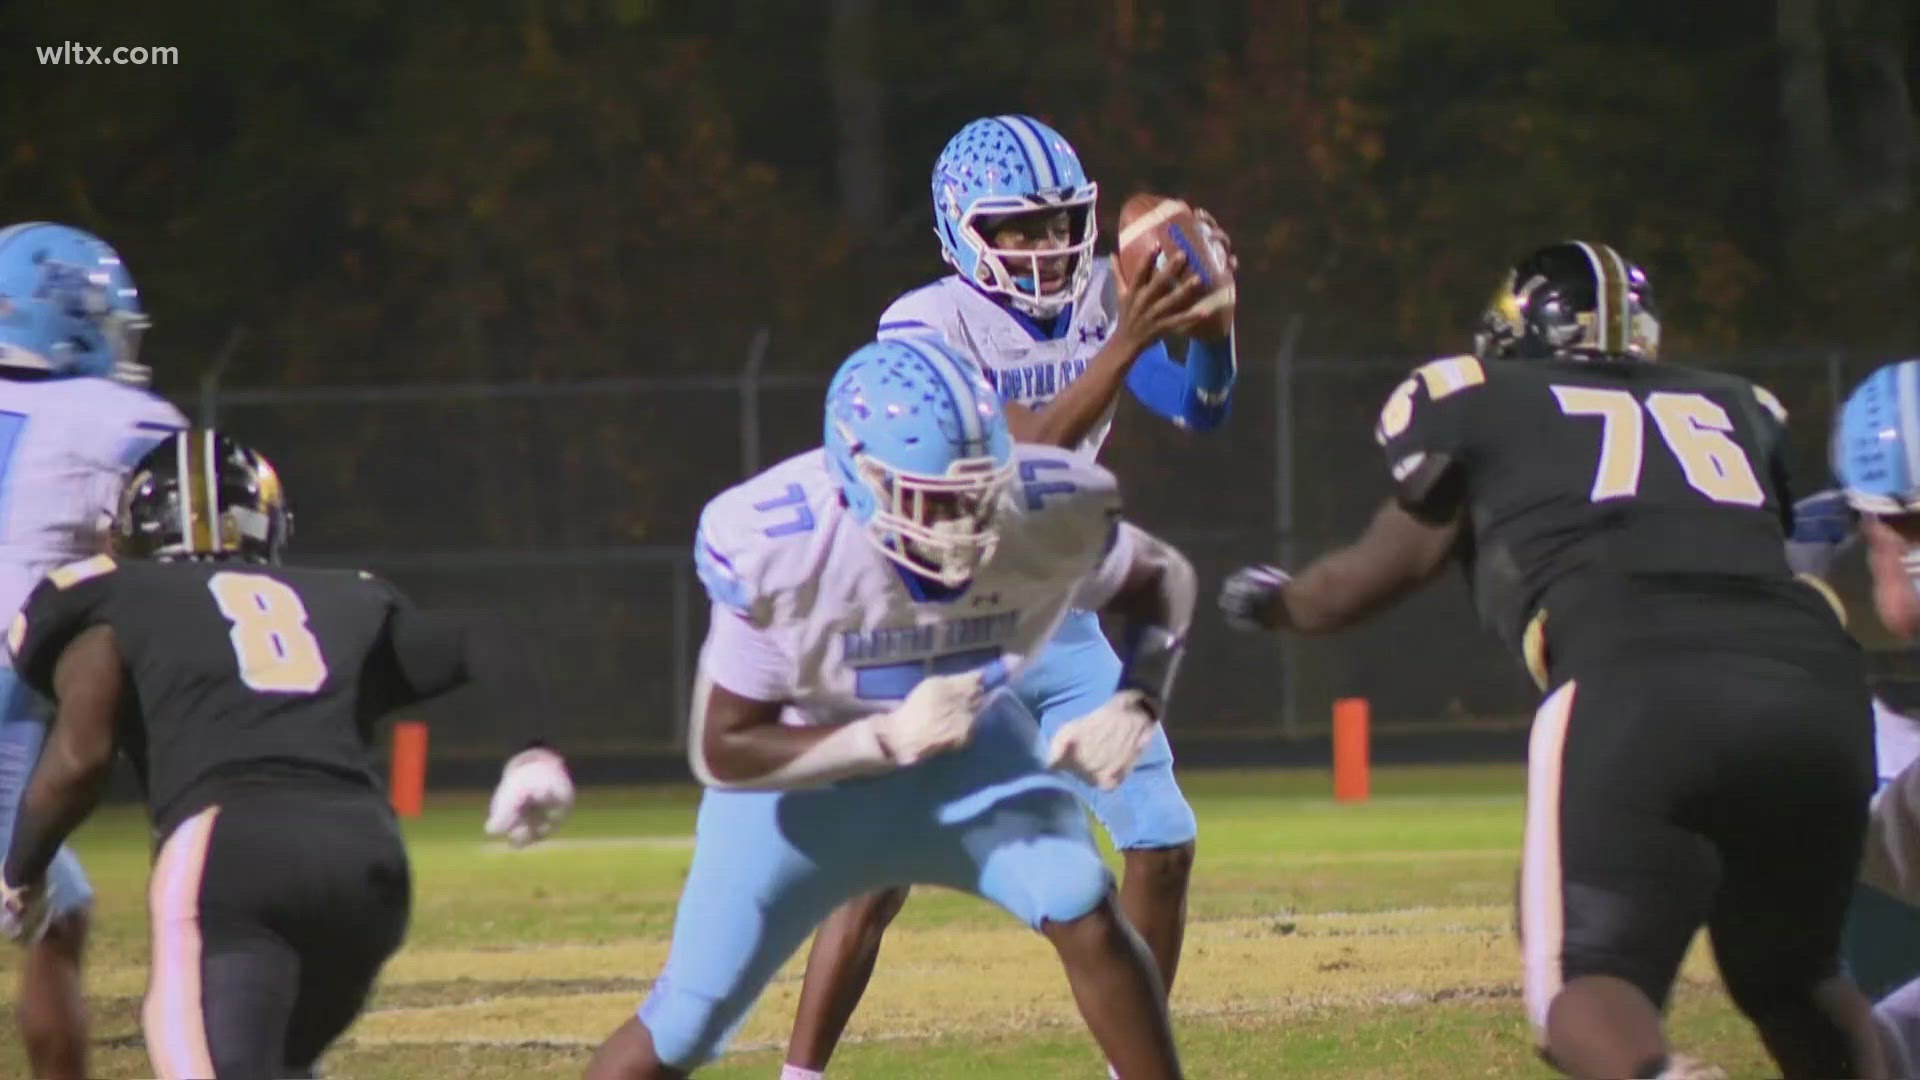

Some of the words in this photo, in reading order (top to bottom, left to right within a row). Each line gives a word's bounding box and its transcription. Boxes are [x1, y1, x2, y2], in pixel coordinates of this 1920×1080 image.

[1550, 384, 1766, 508] 76
[752, 483, 816, 539] 77
[208, 571, 328, 693] 8
